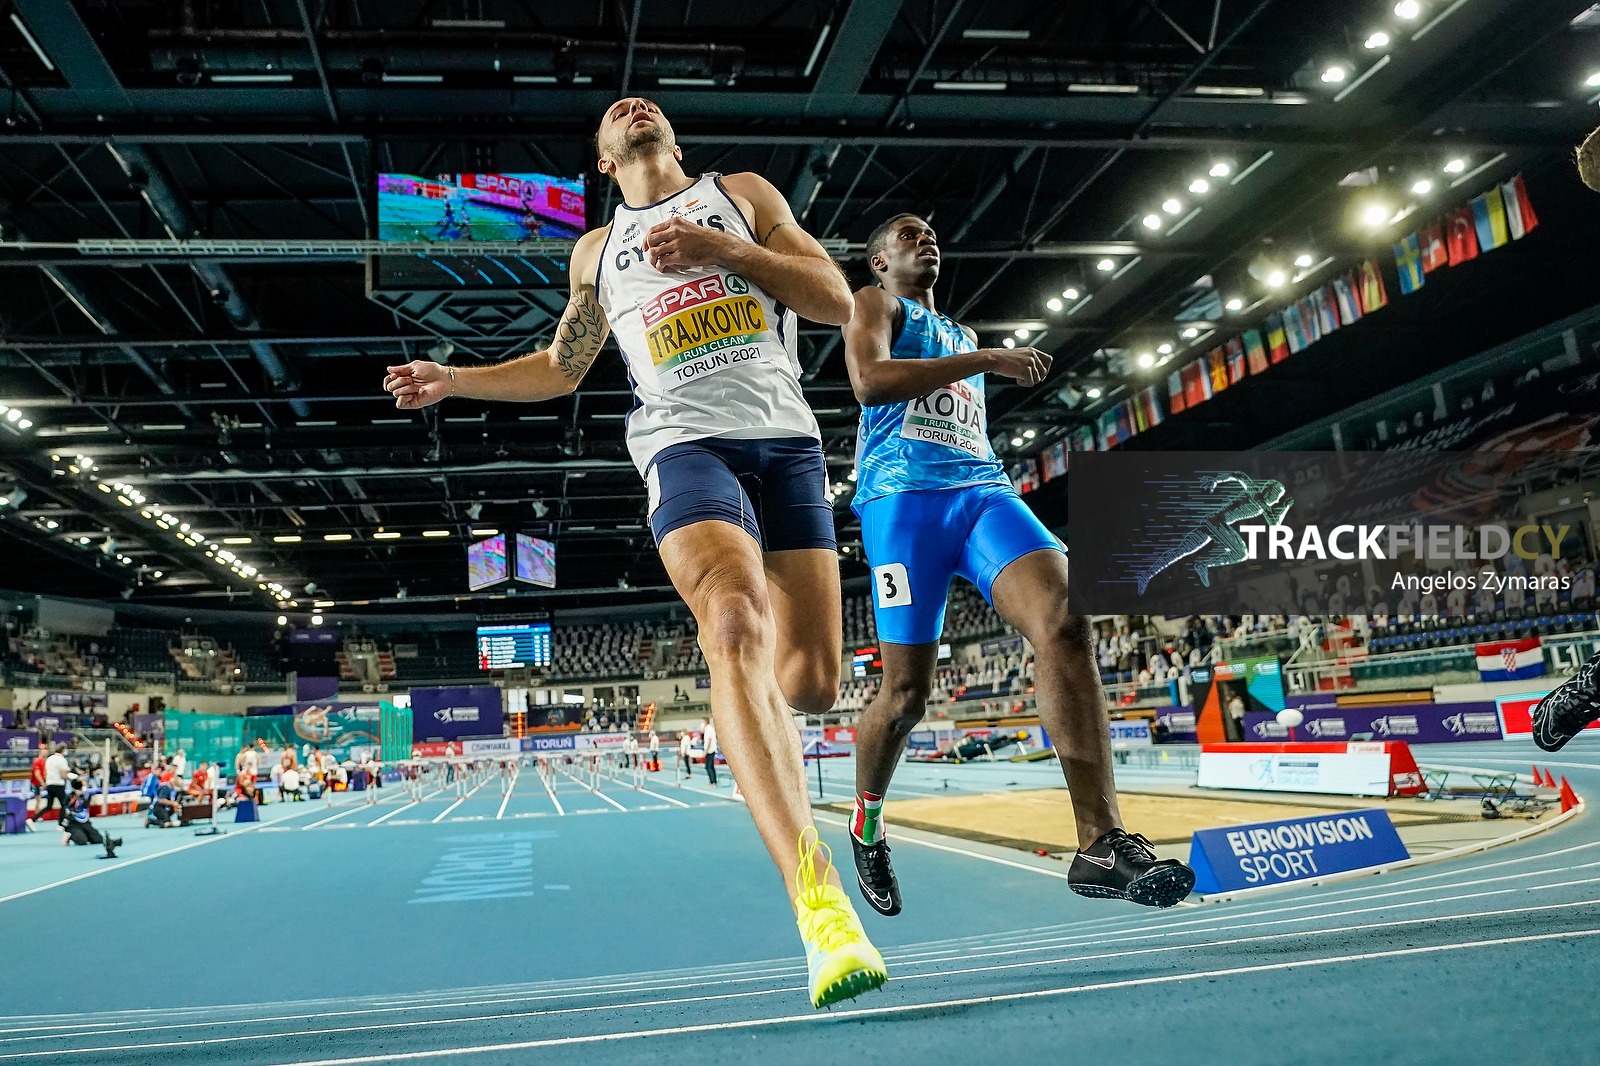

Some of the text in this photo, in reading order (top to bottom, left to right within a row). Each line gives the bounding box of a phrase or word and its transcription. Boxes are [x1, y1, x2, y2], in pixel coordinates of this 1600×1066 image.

[475, 173, 520, 195] SPAR
[615, 214, 726, 271] CYS
[643, 278, 723, 324] SPAR
[649, 299, 761, 358] TRAJKOVIC
[673, 346, 762, 381] TORUŃ 2021
[683, 346, 708, 360] RUN
[913, 392, 982, 434] KOUA
[928, 419, 949, 429] RUN
[959, 438, 980, 455] 2021
[883, 572, 897, 599] 3
[1550, 644, 1579, 669] L1
[534, 736, 573, 749] TORUŃ
[1239, 850, 1319, 883] SPORT
